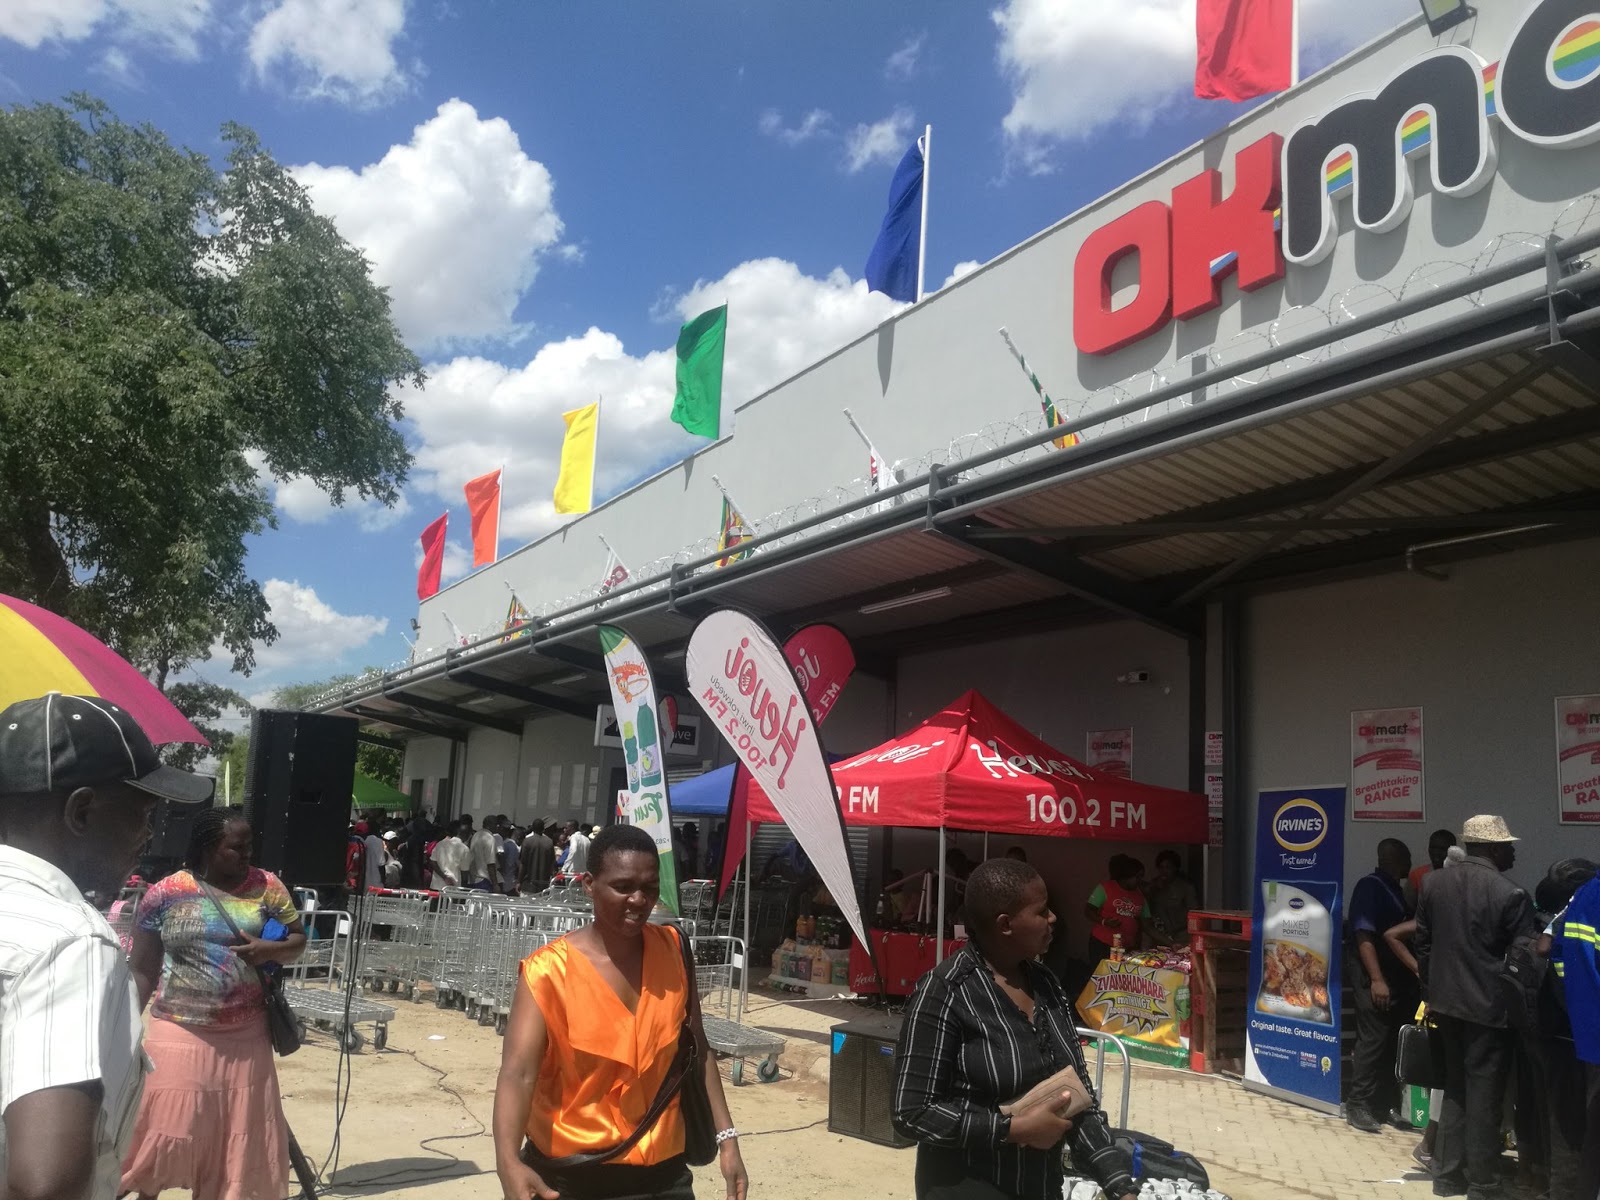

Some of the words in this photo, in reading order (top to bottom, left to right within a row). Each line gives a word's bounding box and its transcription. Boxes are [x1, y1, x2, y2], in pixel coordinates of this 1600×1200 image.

[819, 682, 841, 708] FM
[1358, 722, 1409, 737] OKmart
[1355, 775, 1419, 796] Breathtaking
[848, 785, 879, 813] FM
[1364, 786, 1411, 805] RANGE
[1026, 793, 1101, 827] 100.2
[1110, 801, 1147, 830] FM
[1278, 818, 1323, 832] IRVINE'S
[1279, 853, 1296, 866] Trust
[1282, 919, 1310, 930] MIXED
[1282, 928, 1310, 936] PORTIONS
[1251, 1020, 1275, 1032] Original
[1275, 1024, 1293, 1035] taste.
[1294, 1027, 1312, 1039] Great
[1313, 1031, 1338, 1043] flavour.
